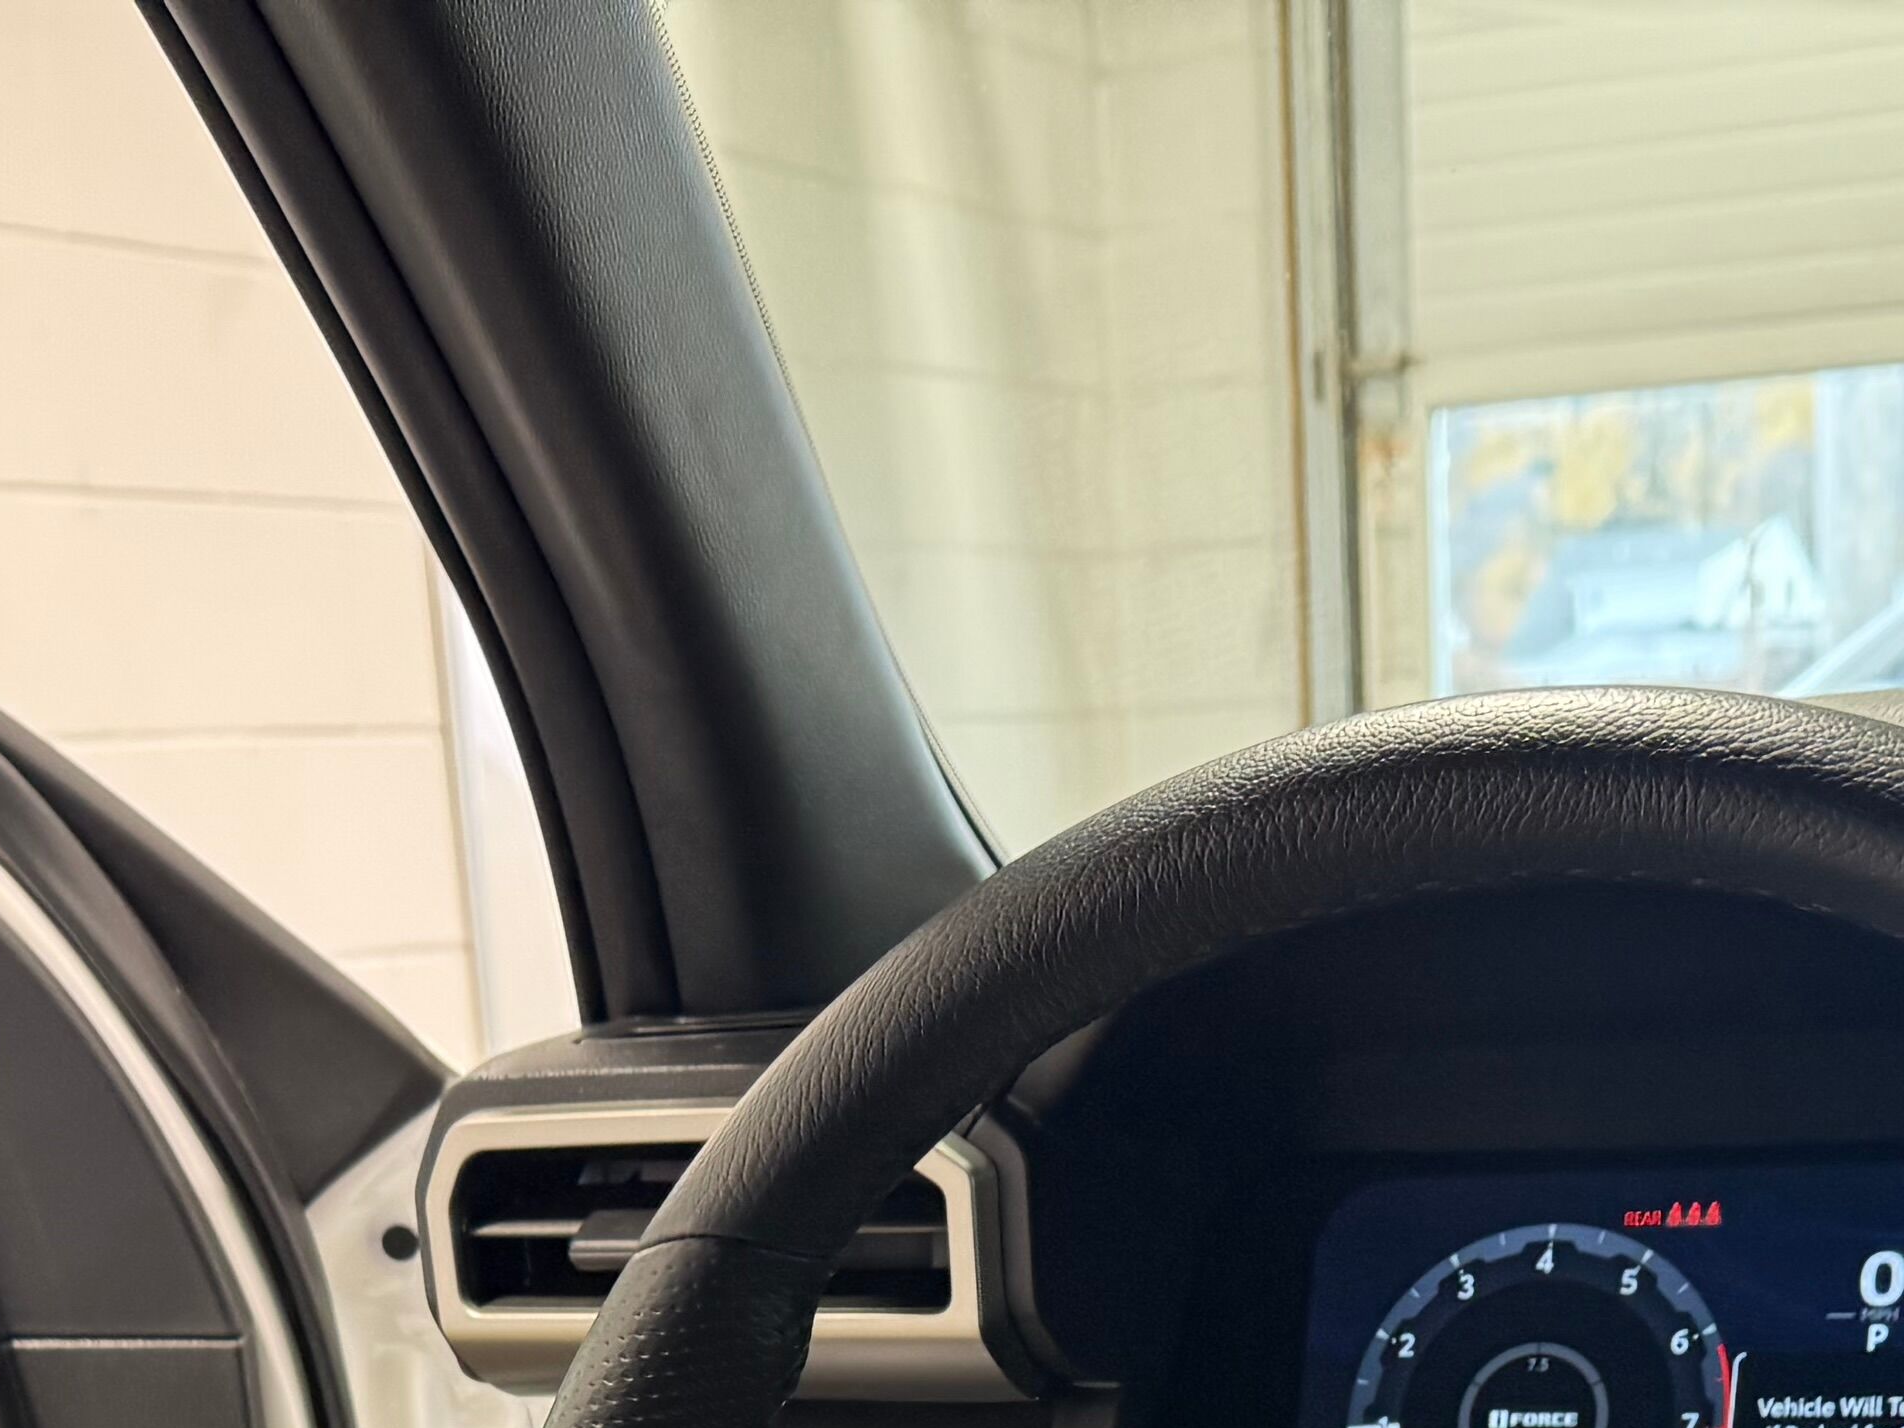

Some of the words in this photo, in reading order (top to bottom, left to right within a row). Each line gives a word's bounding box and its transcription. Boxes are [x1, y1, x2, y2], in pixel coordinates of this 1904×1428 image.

[1536, 1250, 1555, 1274] 4
[1457, 1274, 1475, 1300] 3
[1620, 1269, 1639, 1295] 5
[1397, 1333, 1416, 1358] 2
[1670, 1328, 1689, 1355] 6
[1866, 1323, 1889, 1353] P
[1757, 1397, 1835, 1419] Vehicle
[1840, 1397, 1883, 1417] Will
